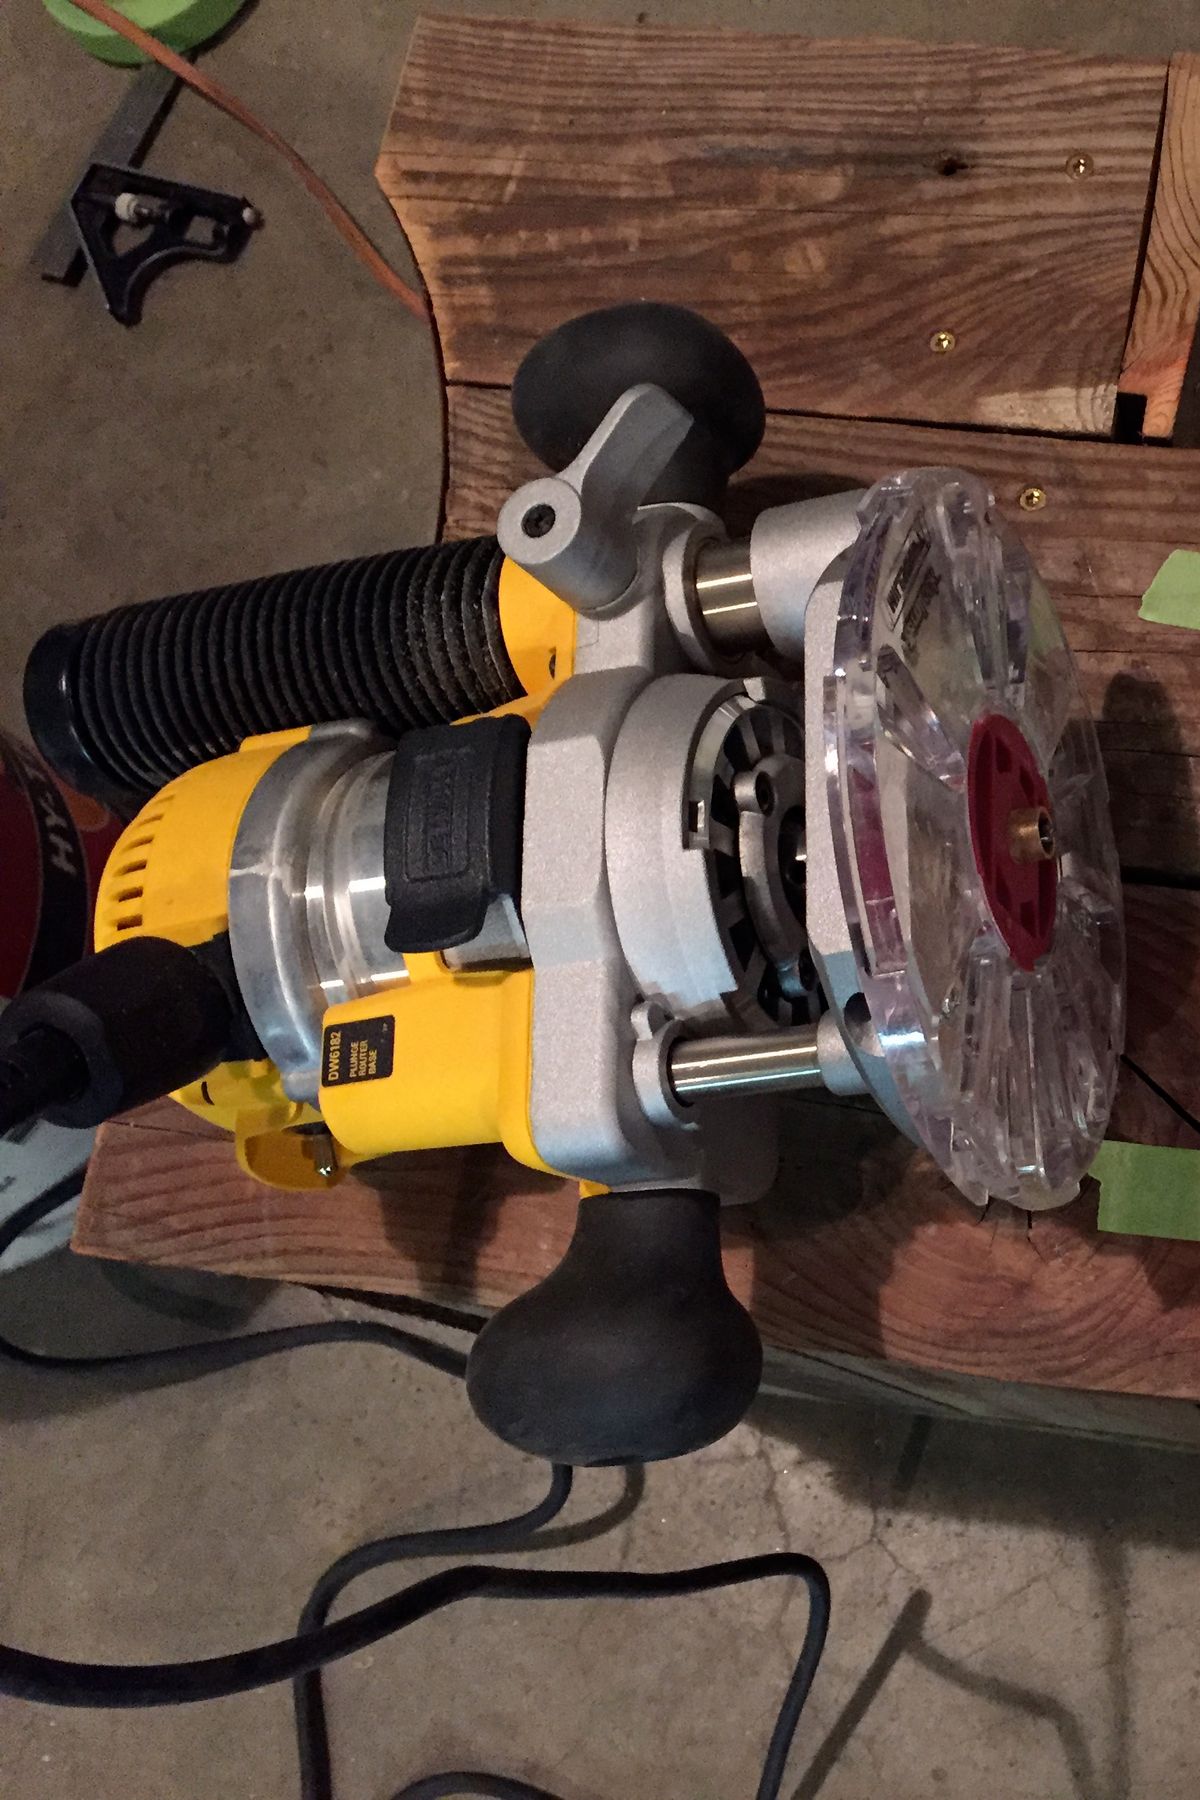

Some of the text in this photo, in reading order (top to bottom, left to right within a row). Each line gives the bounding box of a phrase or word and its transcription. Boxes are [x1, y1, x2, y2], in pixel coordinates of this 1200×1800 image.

[328, 1031, 342, 1081] DW6182
[349, 1041, 359, 1078] PLUNGE
[359, 1039, 369, 1076] ROUTER
[368, 1049, 377, 1075] BASE
